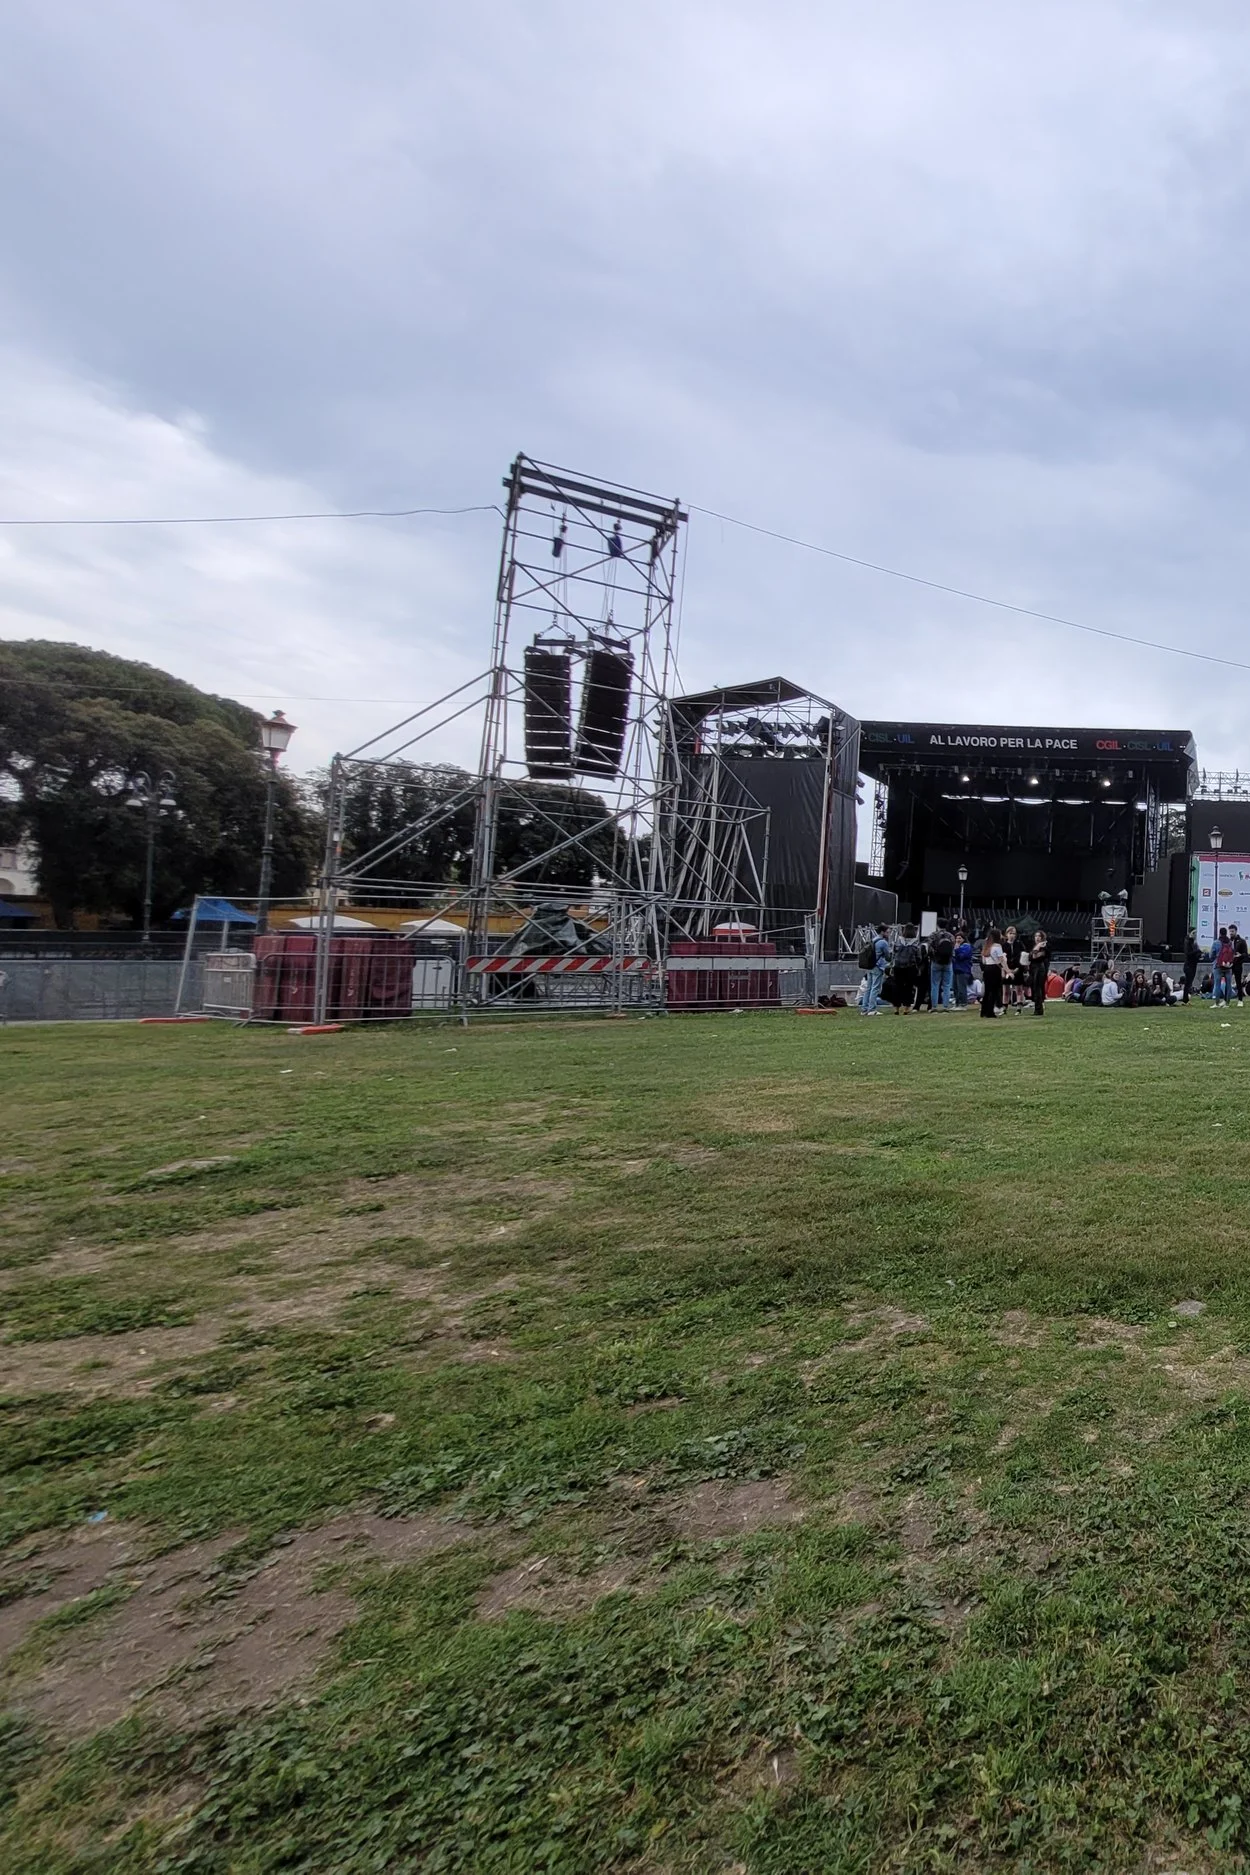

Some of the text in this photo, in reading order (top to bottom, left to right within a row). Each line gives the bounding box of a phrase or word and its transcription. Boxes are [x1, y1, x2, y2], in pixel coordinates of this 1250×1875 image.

[869, 733, 1174, 751] CISL UIL AL LAVORO PER LA PACE CGIL CISL UIL
